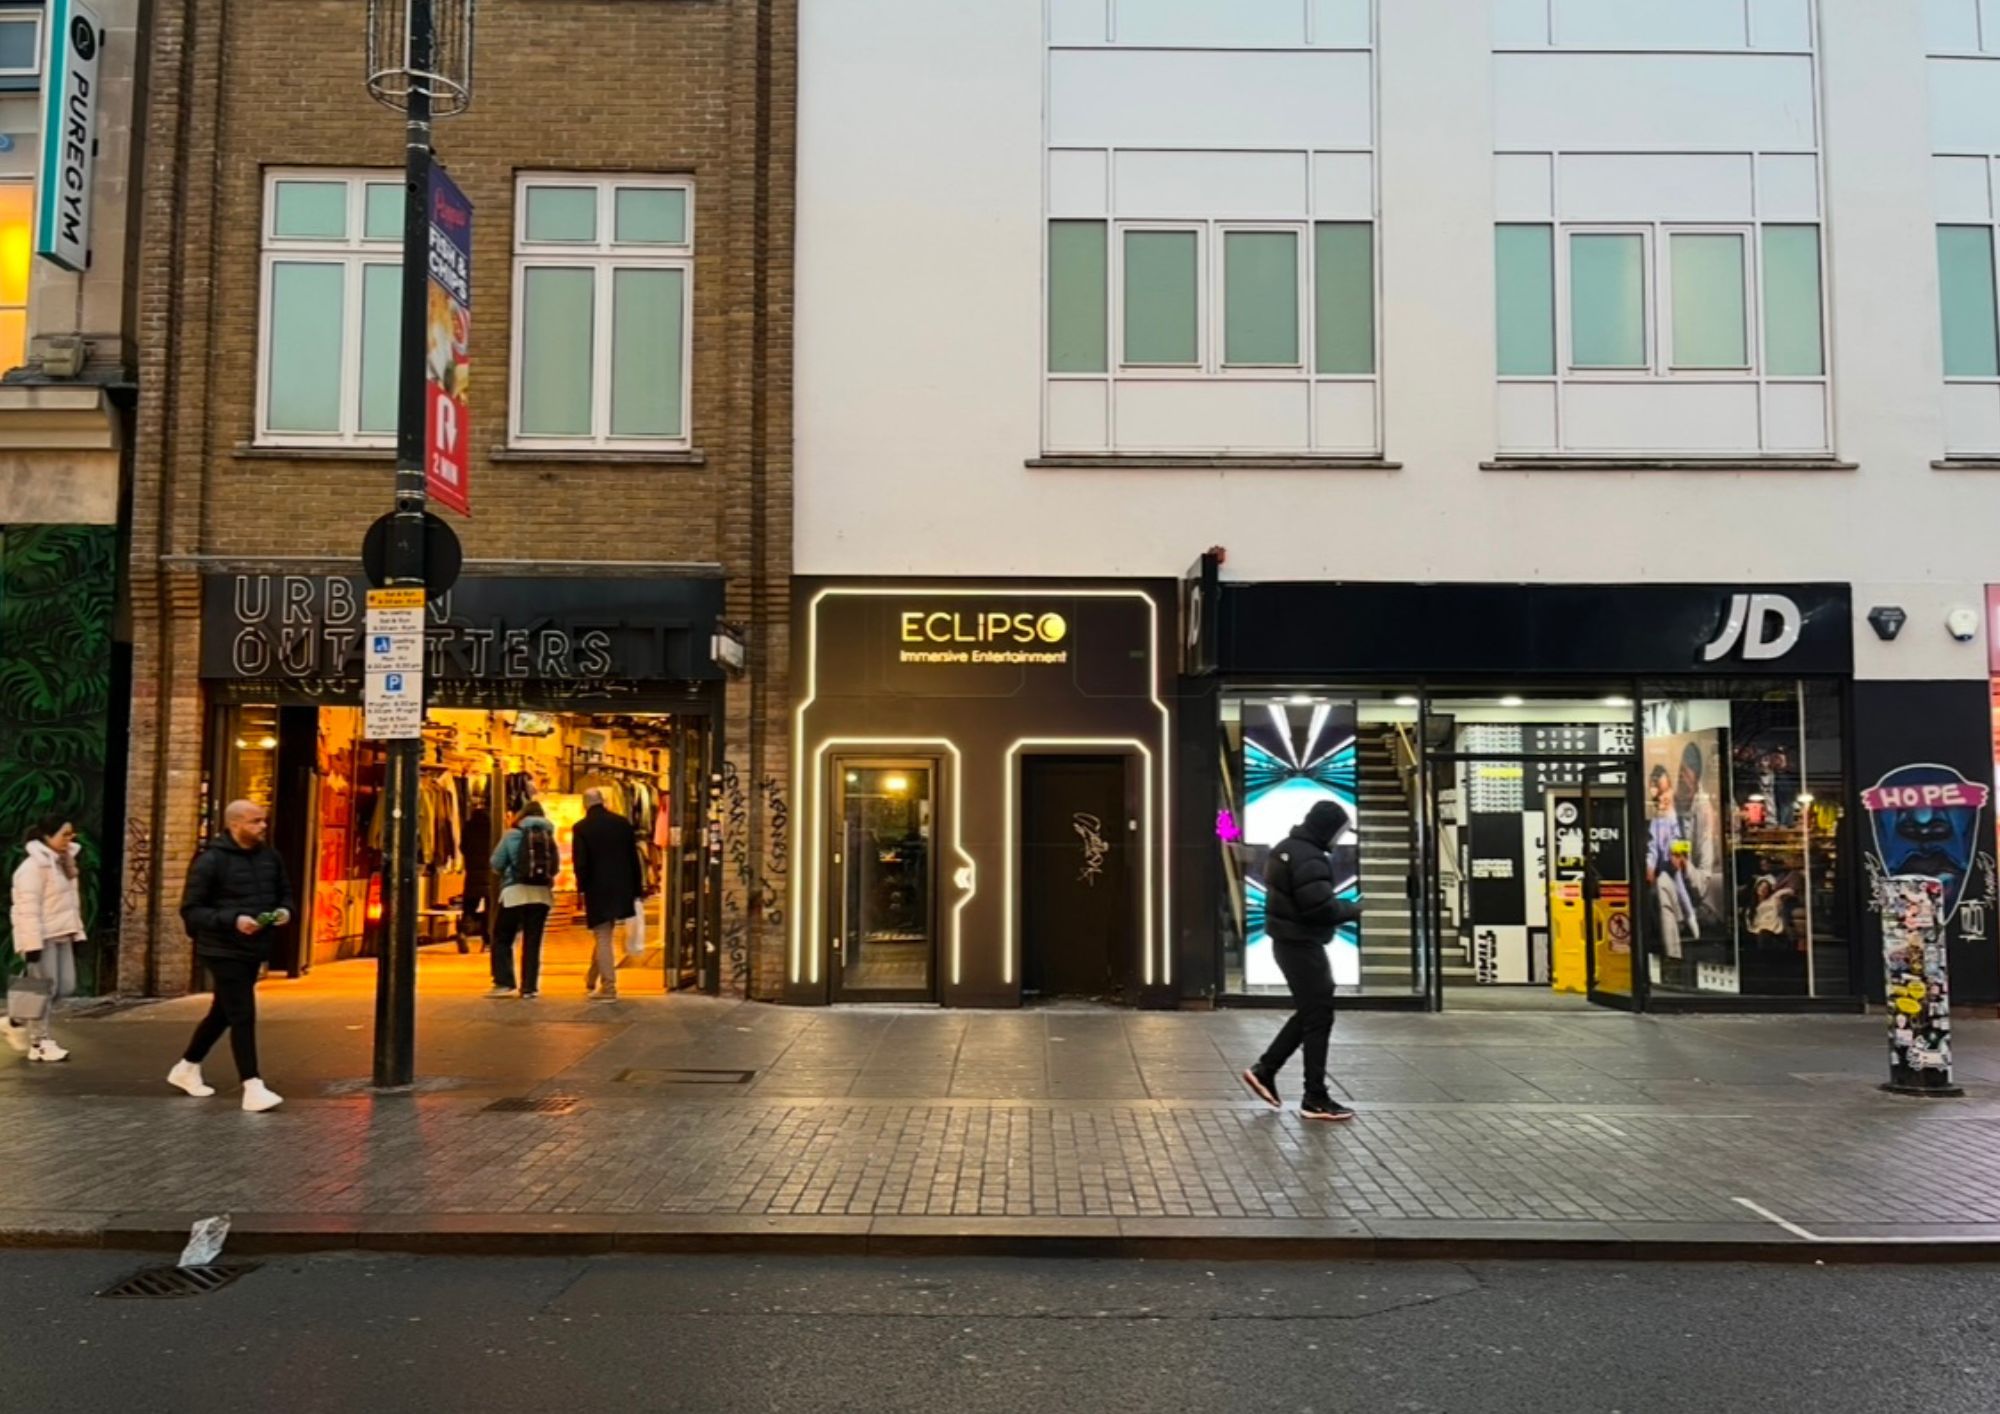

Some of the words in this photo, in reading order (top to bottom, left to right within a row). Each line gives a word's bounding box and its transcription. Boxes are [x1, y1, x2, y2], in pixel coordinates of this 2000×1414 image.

[62, 70, 90, 246] PUREGYM
[429, 225, 456, 269] FISH
[429, 251, 467, 300] CHIPS
[432, 452, 439, 474] 2
[234, 576, 453, 625] URBN
[1704, 594, 1800, 661] JD
[233, 628, 612, 678] OUTTTERS
[900, 650, 969, 663] Immersive
[971, 650, 1067, 664] Entertainment
[389, 675, 400, 690] P
[1879, 783, 1967, 808] HOPE
